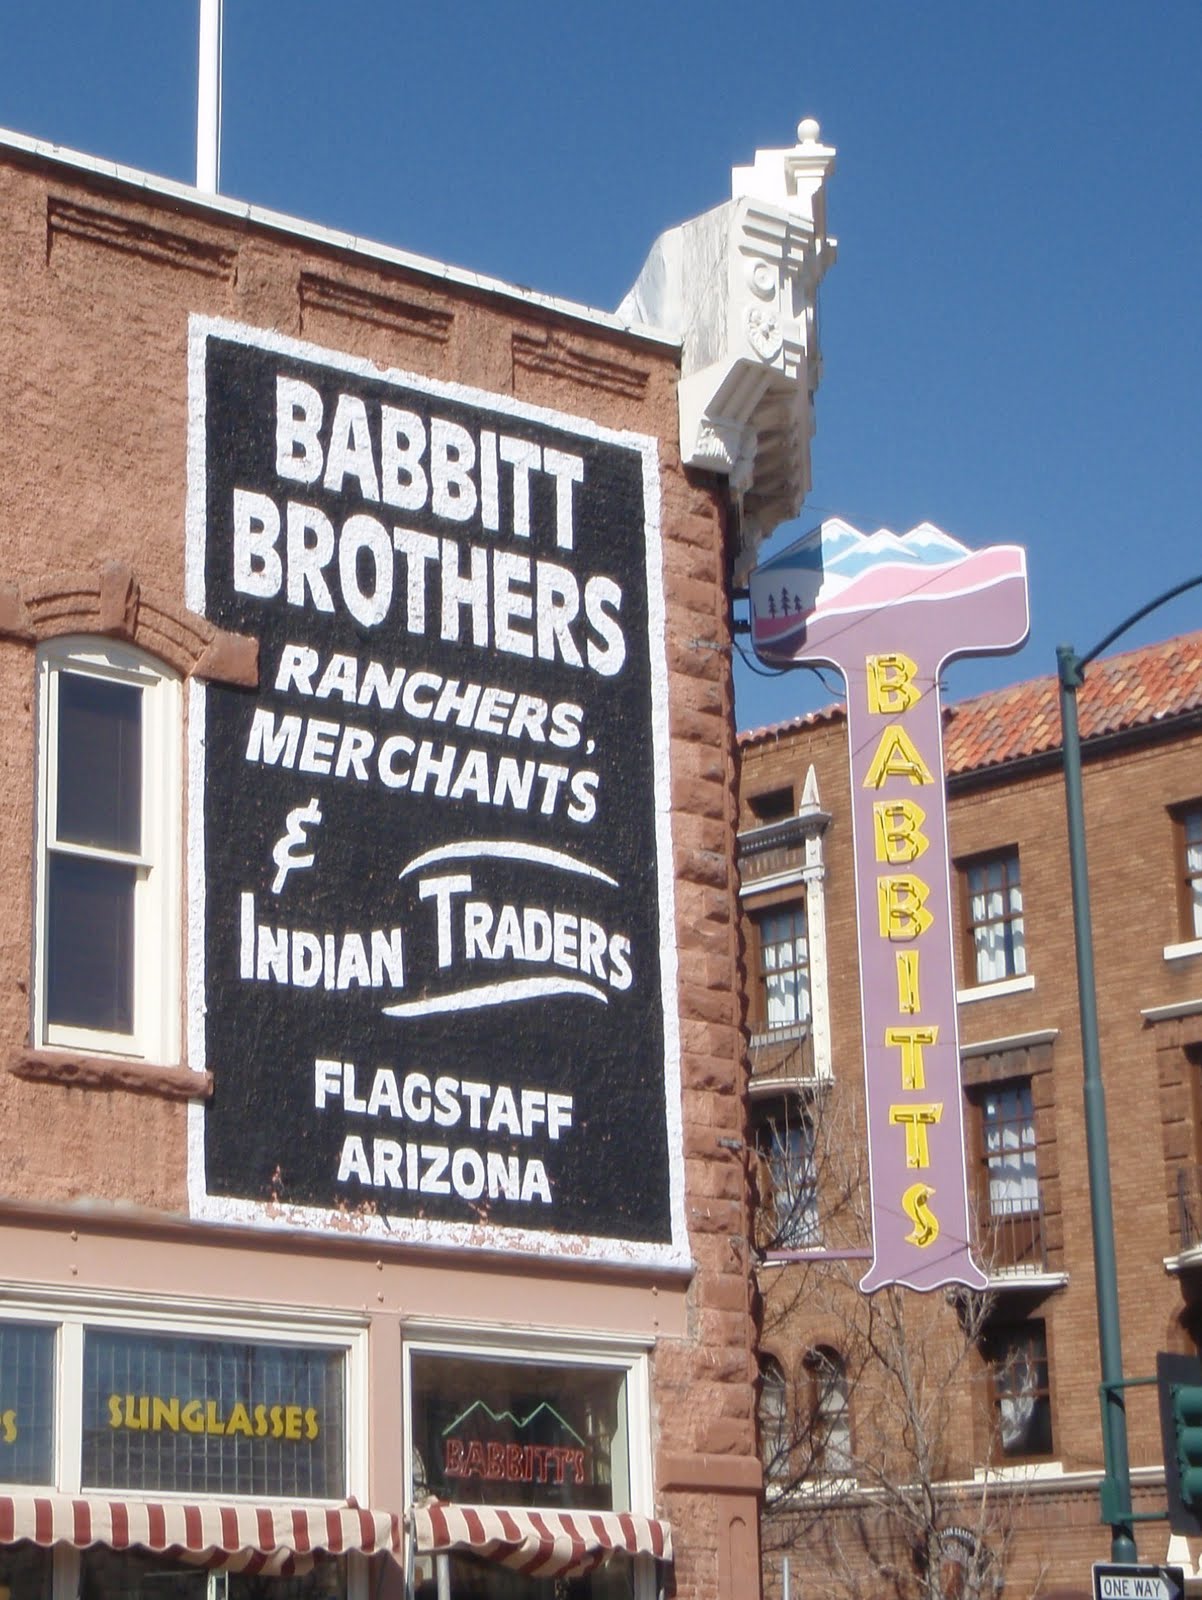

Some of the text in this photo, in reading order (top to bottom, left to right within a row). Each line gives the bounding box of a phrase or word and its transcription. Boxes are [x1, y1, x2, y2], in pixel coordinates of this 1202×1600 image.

[276, 375, 584, 550] BABBITT
[233, 488, 628, 677] BROTHERS
[274, 644, 596, 754] RANCHERS,
[245, 708, 600, 823] MERCHANTS
[272, 798, 322, 894] &
[240, 874, 633, 990] INDIAN TRADERS
[862, 652, 944, 1248] BABBITTS
[315, 1059, 574, 1140] FLAGSTAFF
[337, 1135, 553, 1204] ARIZONA
[0, 1409, 17, 1443] S
[107, 1394, 320, 1441] SUNGLASSES
[444, 1439, 586, 1485] BABBITT'S
[1103, 1578, 1161, 1598] ONE WAY
